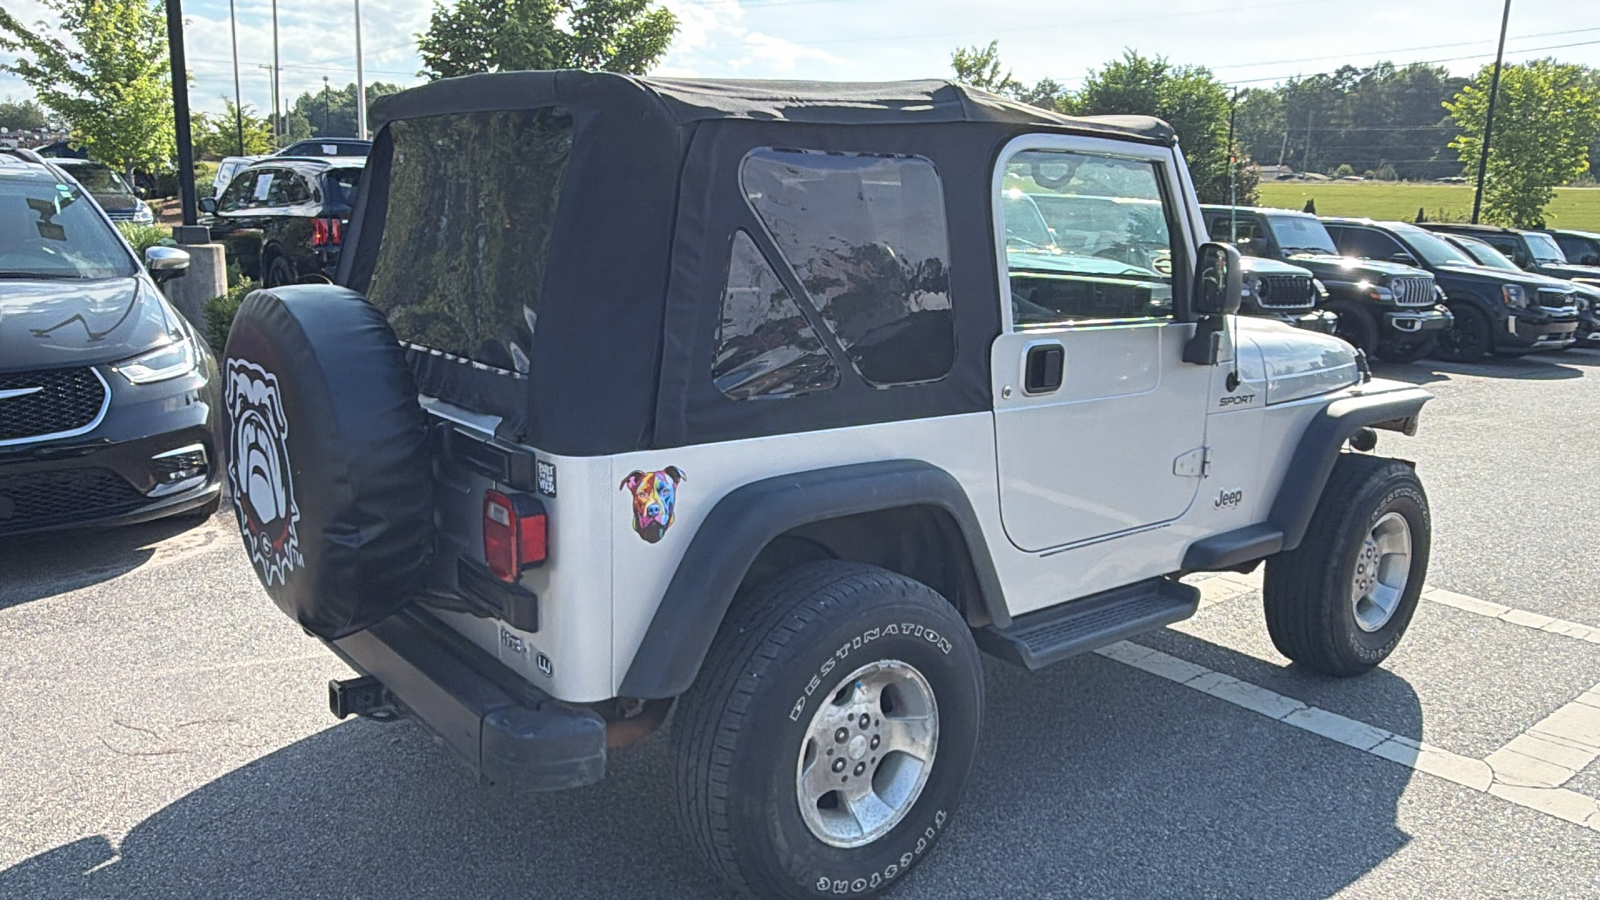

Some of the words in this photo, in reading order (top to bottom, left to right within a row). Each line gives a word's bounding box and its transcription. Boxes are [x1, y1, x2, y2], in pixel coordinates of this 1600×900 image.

[1219, 394, 1256, 407] SPORT
[1214, 490, 1243, 508] Jeep
[789, 622, 953, 721] DESTINATION
[816, 810, 947, 894] Firestone
